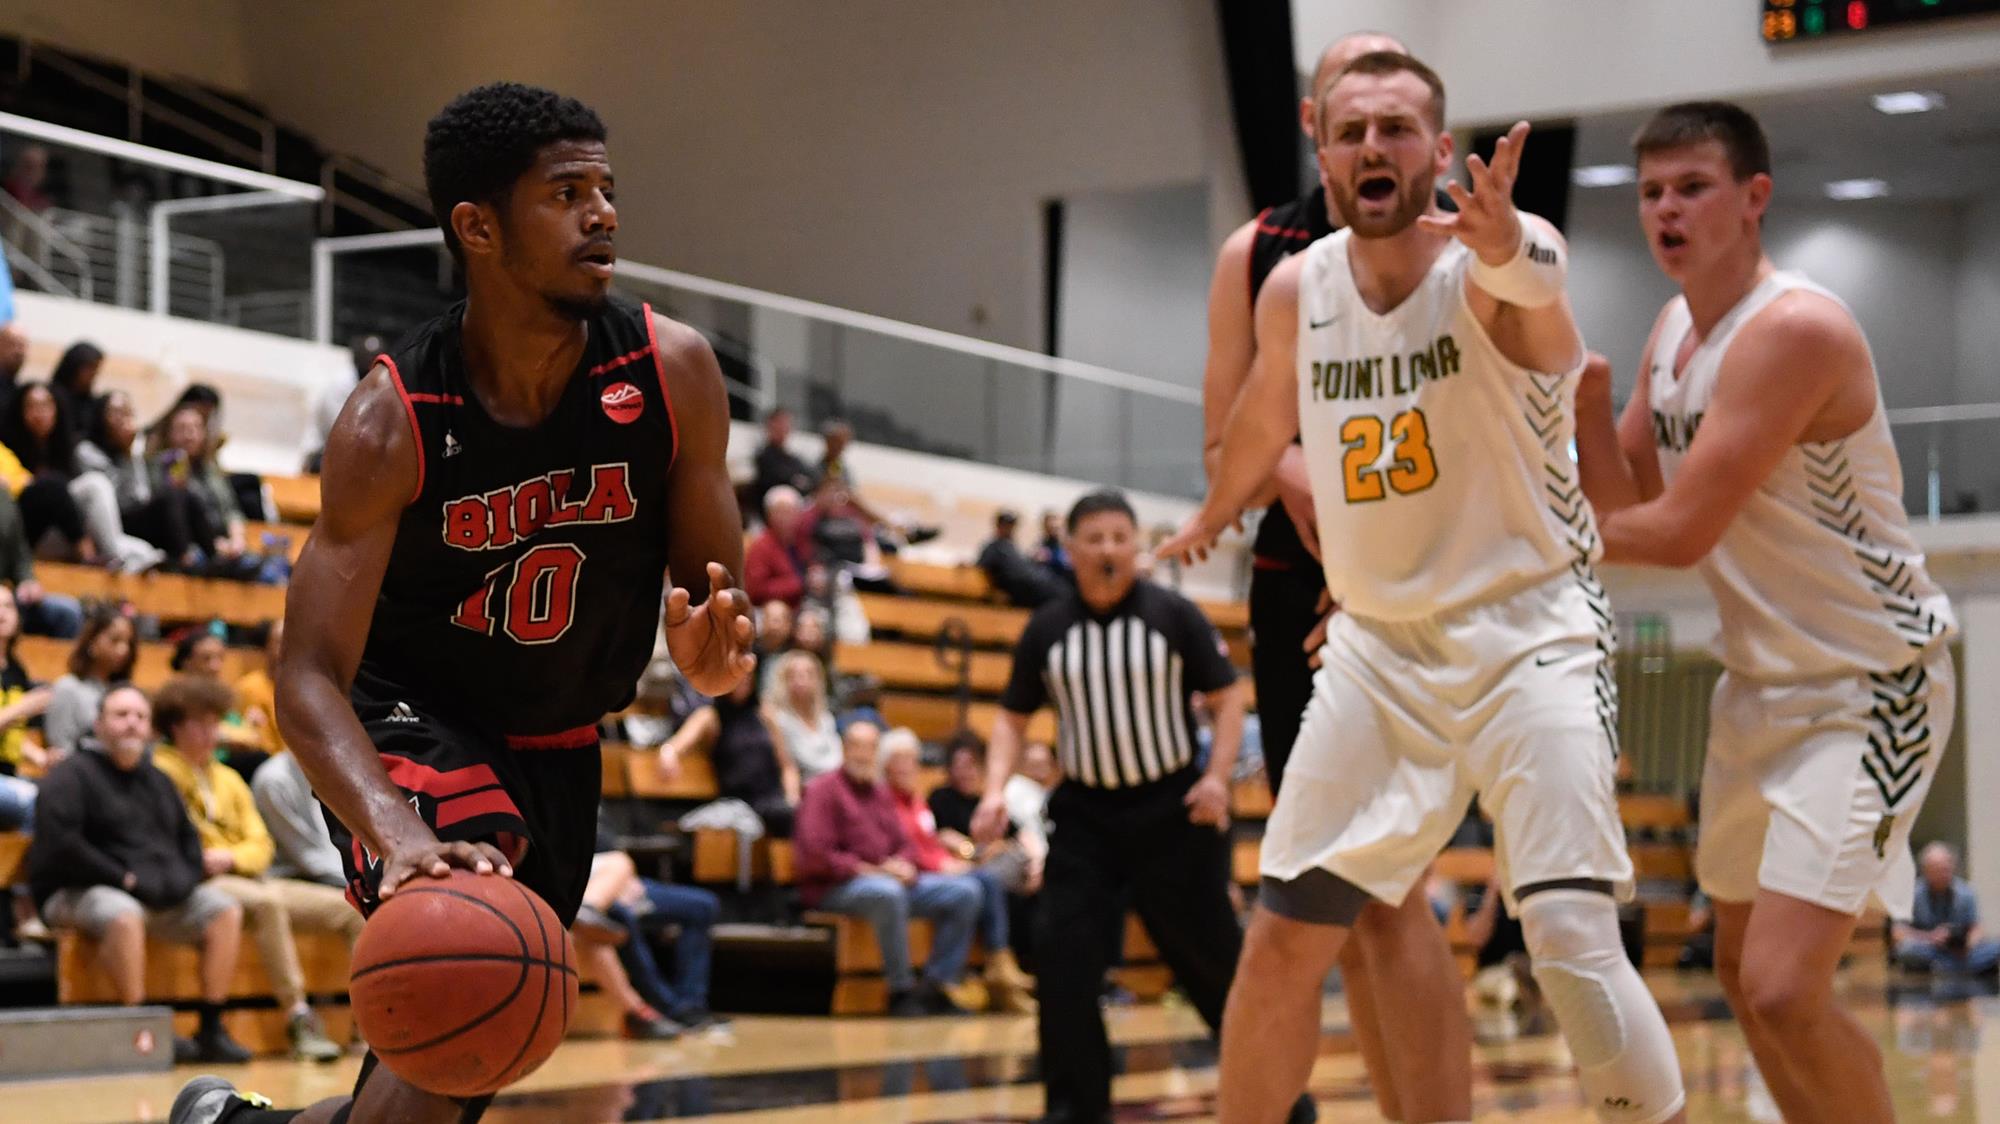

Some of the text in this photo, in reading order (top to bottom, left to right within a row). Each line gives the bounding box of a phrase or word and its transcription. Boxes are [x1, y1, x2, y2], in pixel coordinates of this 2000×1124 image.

[1312, 358, 1383, 402] POINT
[1340, 407, 1439, 504] 23
[442, 462, 637, 551] BIOLA
[451, 543, 587, 644] 10
